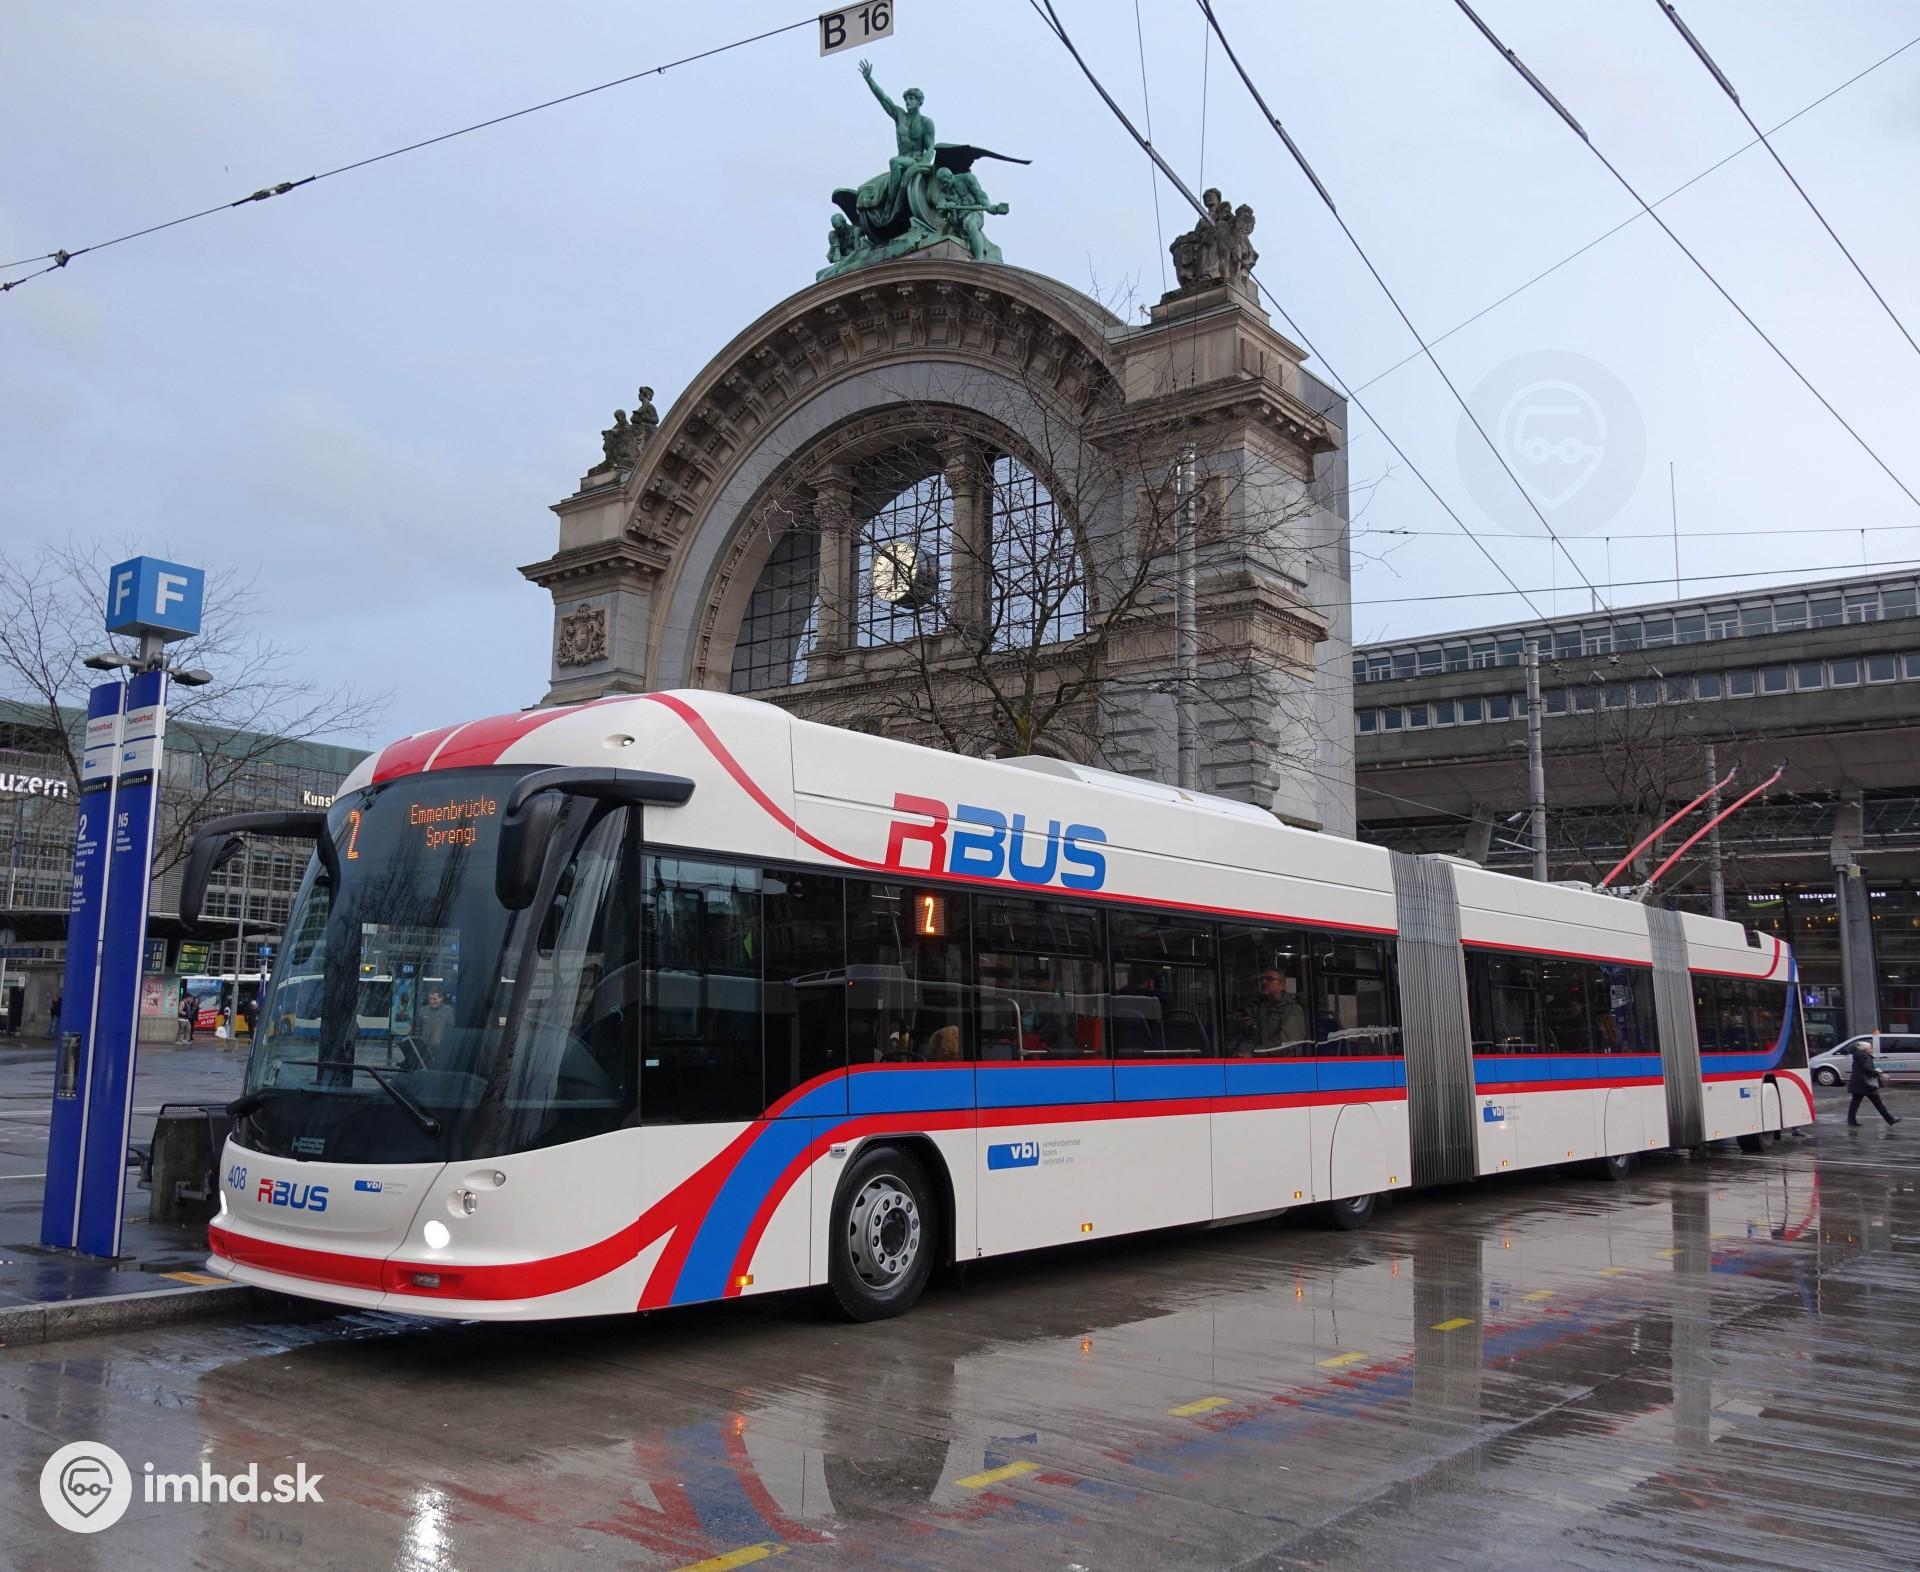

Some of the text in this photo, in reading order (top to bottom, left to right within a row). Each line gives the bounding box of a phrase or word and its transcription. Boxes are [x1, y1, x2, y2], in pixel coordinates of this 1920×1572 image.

[824, 2, 890, 50] B 16
[115, 570, 133, 617] F
[156, 570, 188, 615] F
[0, 772, 68, 799] uzern
[117, 812, 129, 828] N5
[410, 793, 496, 825] Emmenbrücke
[78, 814, 88, 841] 2
[347, 809, 361, 859] 2
[426, 820, 477, 850] Sprengi
[885, 792, 1107, 891] RBUS
[73, 874, 84, 889] N4
[924, 897, 935, 933] 2
[291, 1136, 326, 1155] HESS
[1010, 1141, 1038, 1160] vbl
[228, 1164, 248, 1190] 408
[366, 1180, 382, 1190] vbl
[258, 1178, 329, 1212] RBUS
